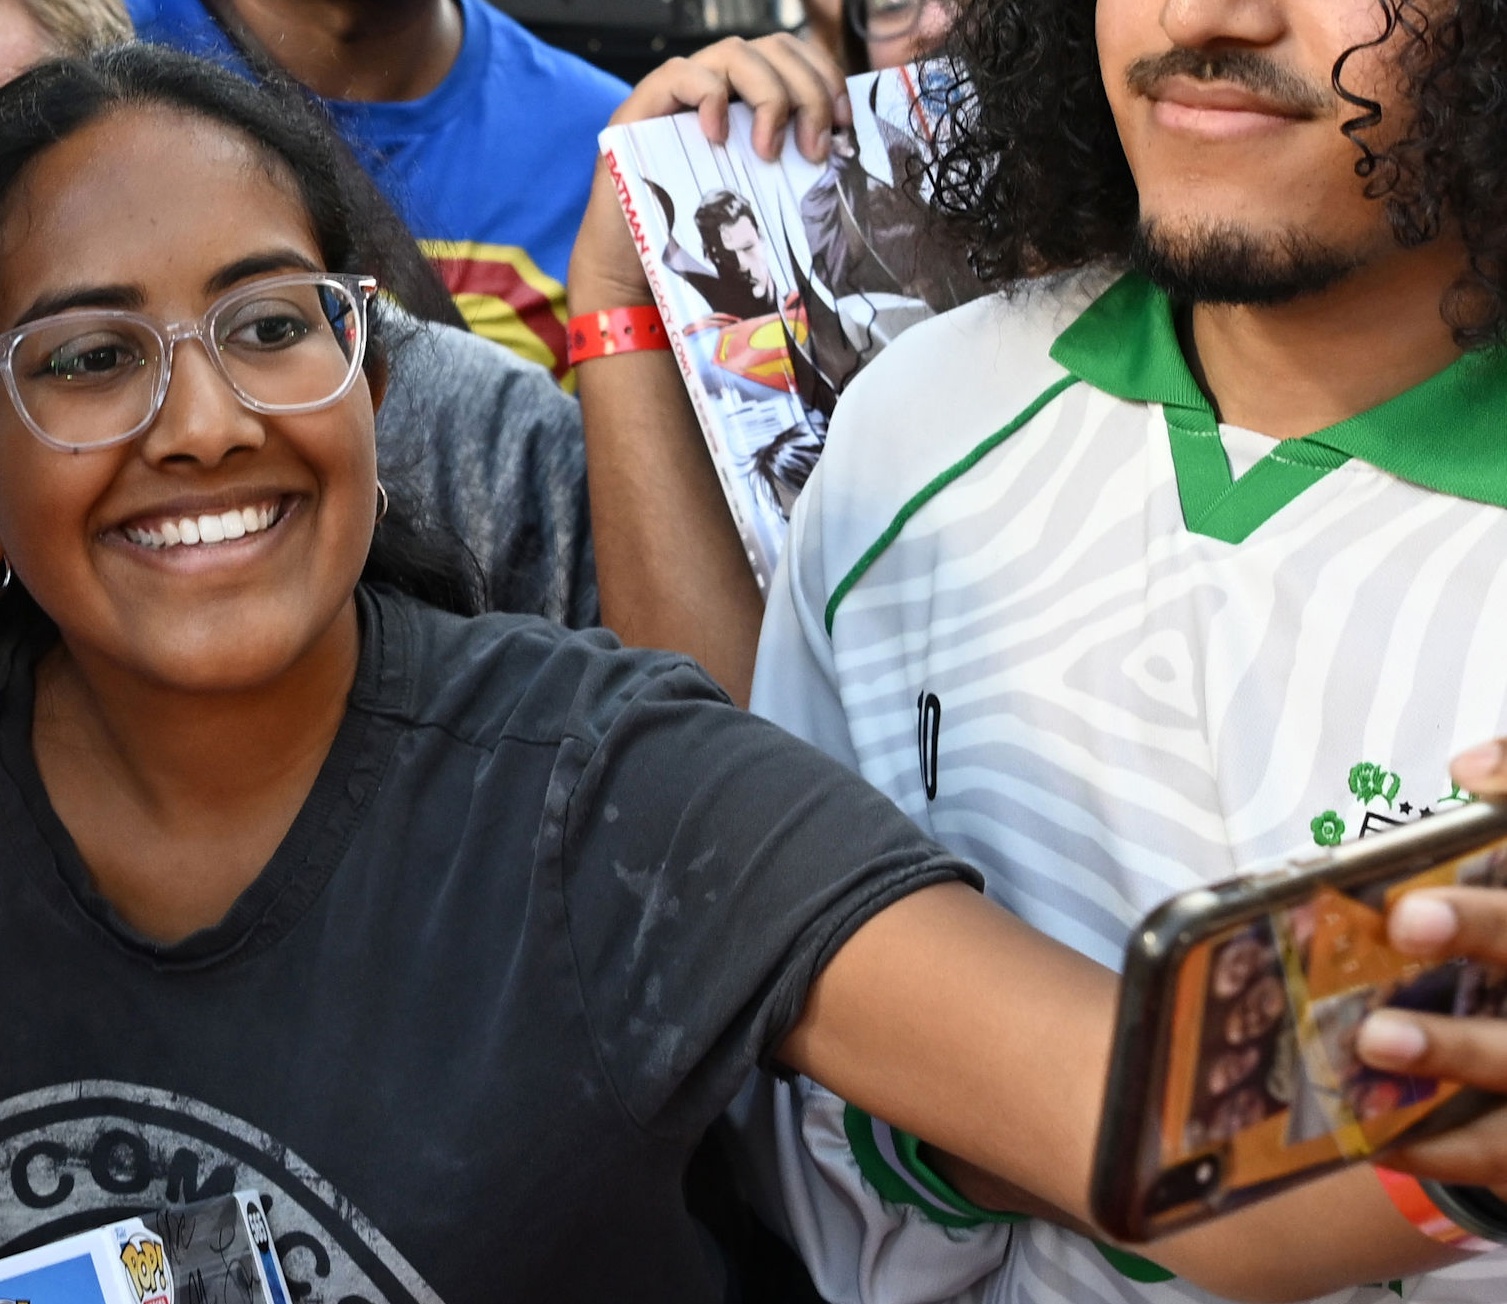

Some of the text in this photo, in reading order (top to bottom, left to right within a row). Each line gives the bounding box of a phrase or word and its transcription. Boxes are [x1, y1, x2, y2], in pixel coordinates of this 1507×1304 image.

[605, 148, 650, 254] BATMAN
[644, 259, 674, 326] LEGACY
[917, 689, 941, 801] 10
[120, 1239, 167, 1303] POP!
